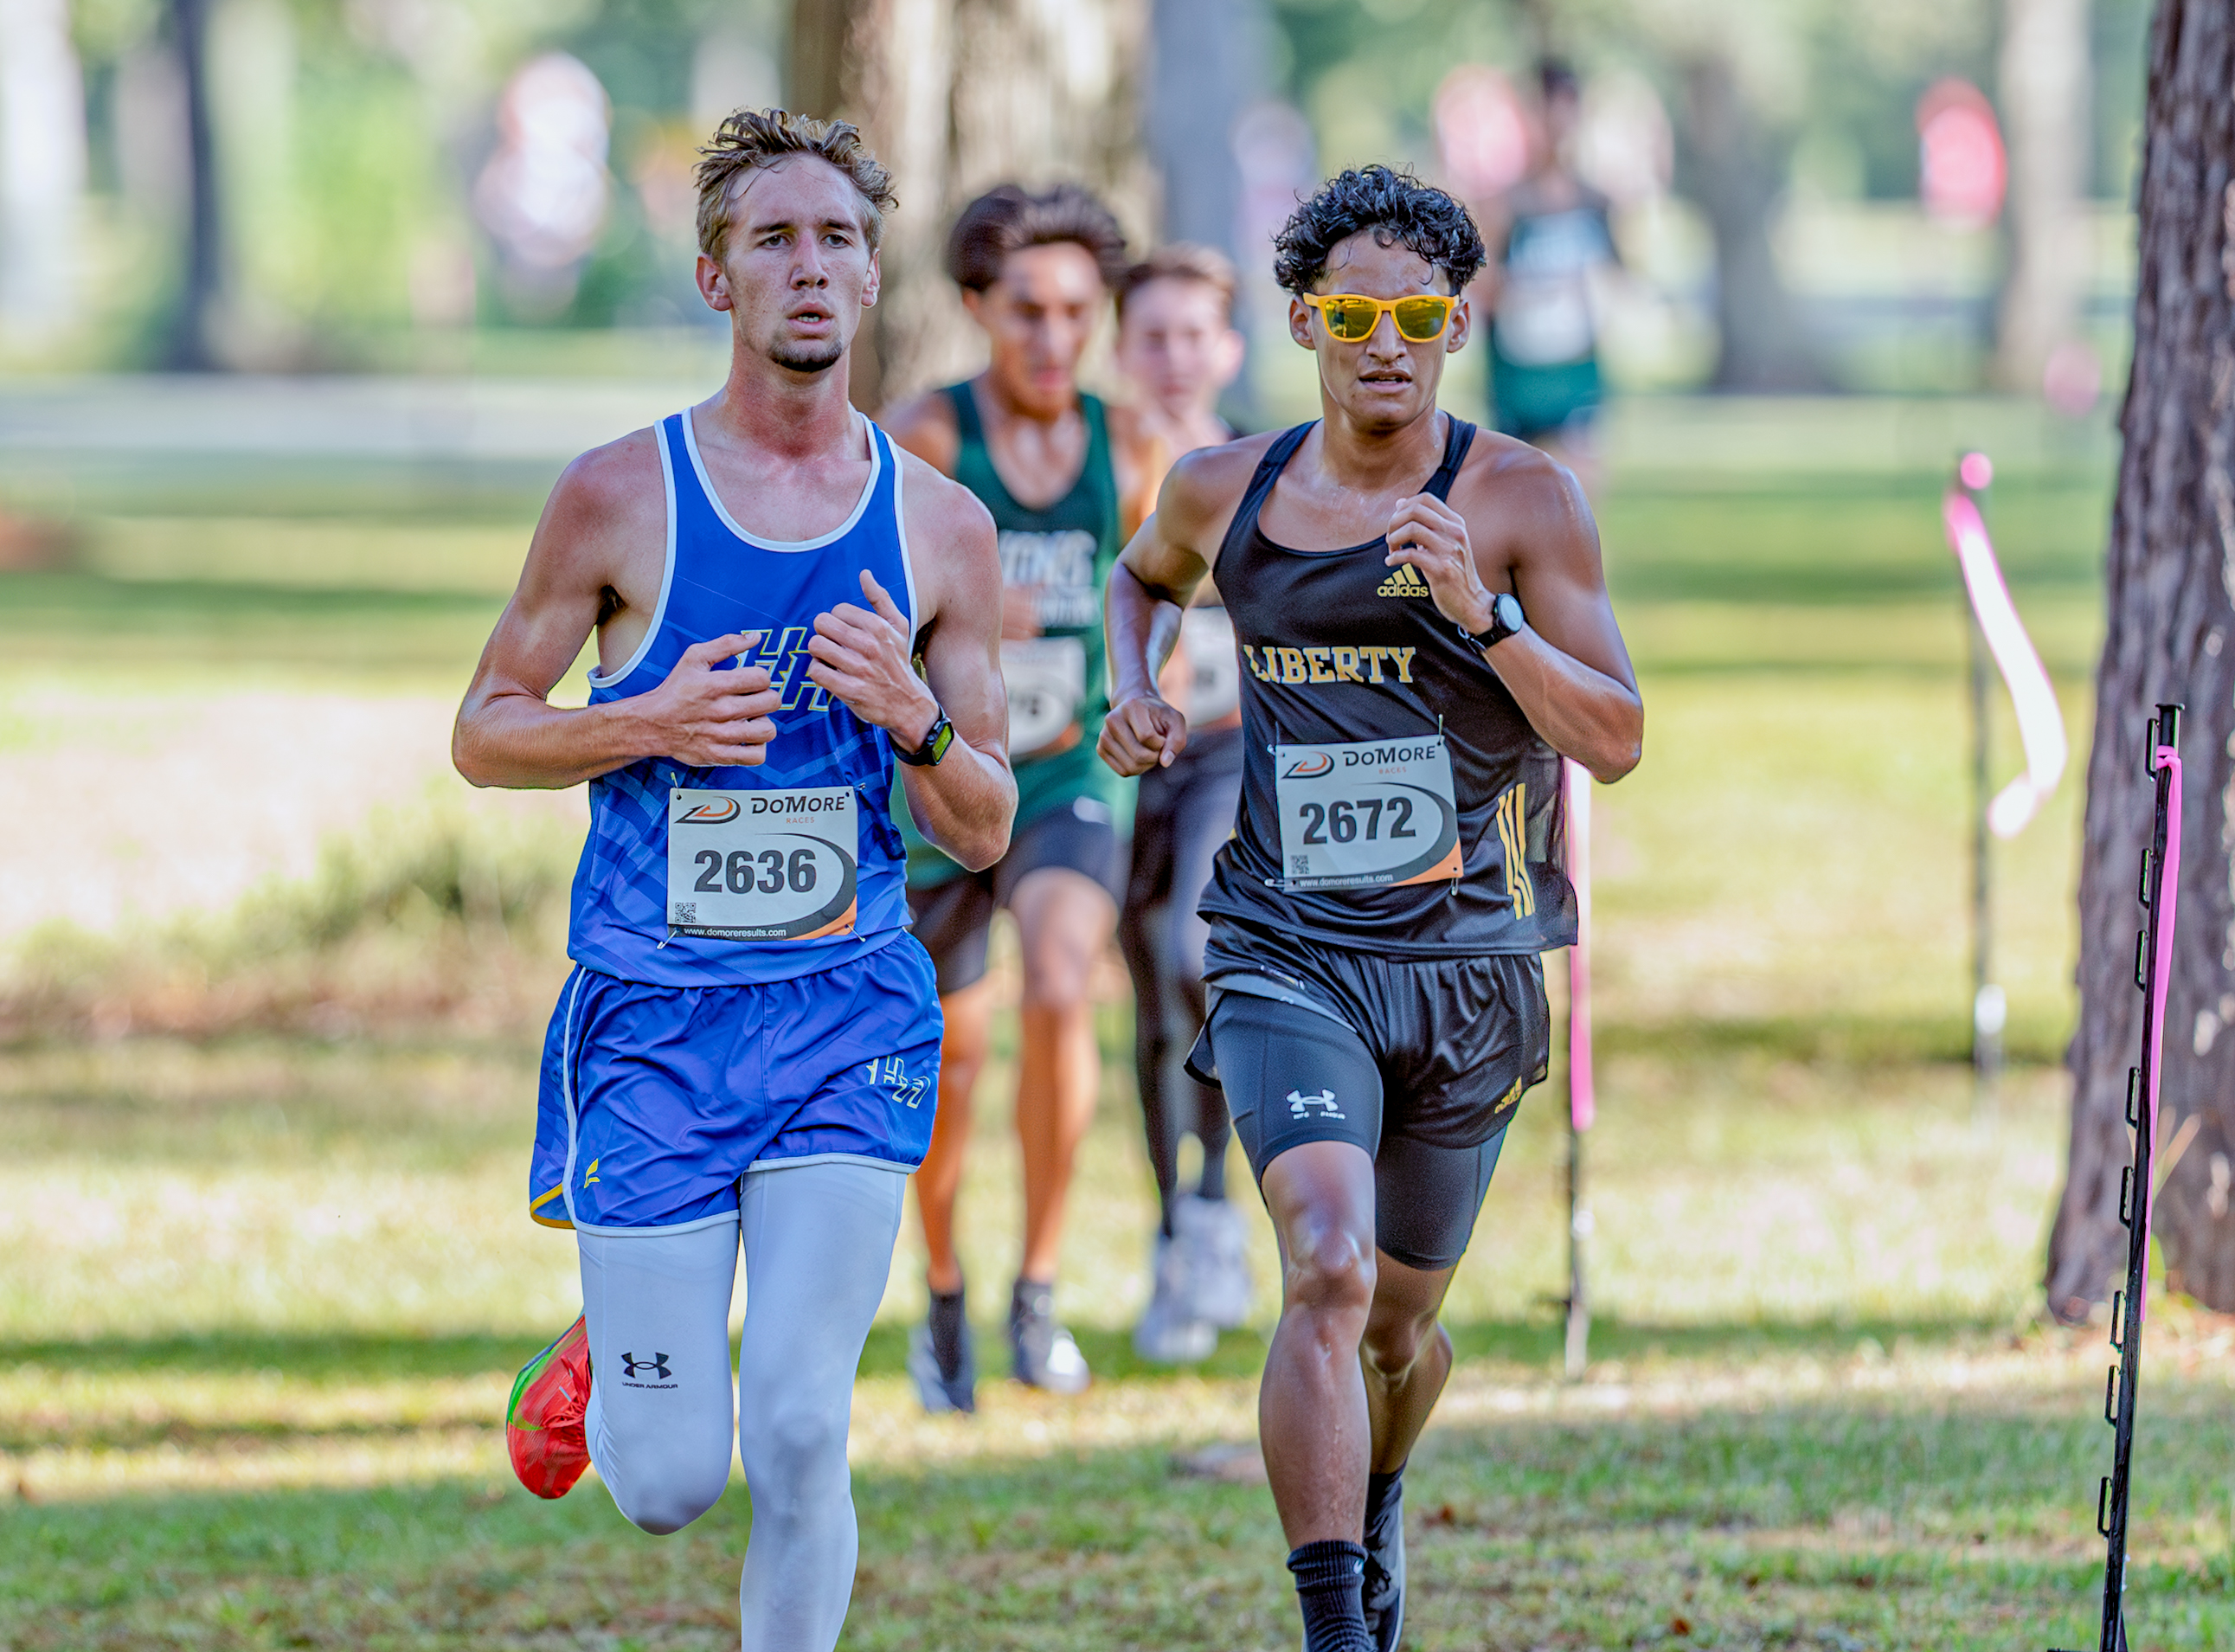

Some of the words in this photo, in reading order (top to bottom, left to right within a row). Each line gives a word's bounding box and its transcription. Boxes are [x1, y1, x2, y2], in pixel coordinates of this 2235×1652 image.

[1377, 583, 1429, 597] adidas
[1243, 645, 1416, 684] LIBERTY
[786, 816, 815, 825] RACES
[1300, 796, 1416, 845] 2672
[693, 848, 817, 894] 2636
[1299, 873, 1394, 888] www.domoreresults.com
[684, 926, 787, 937] www.domoreresults.com
